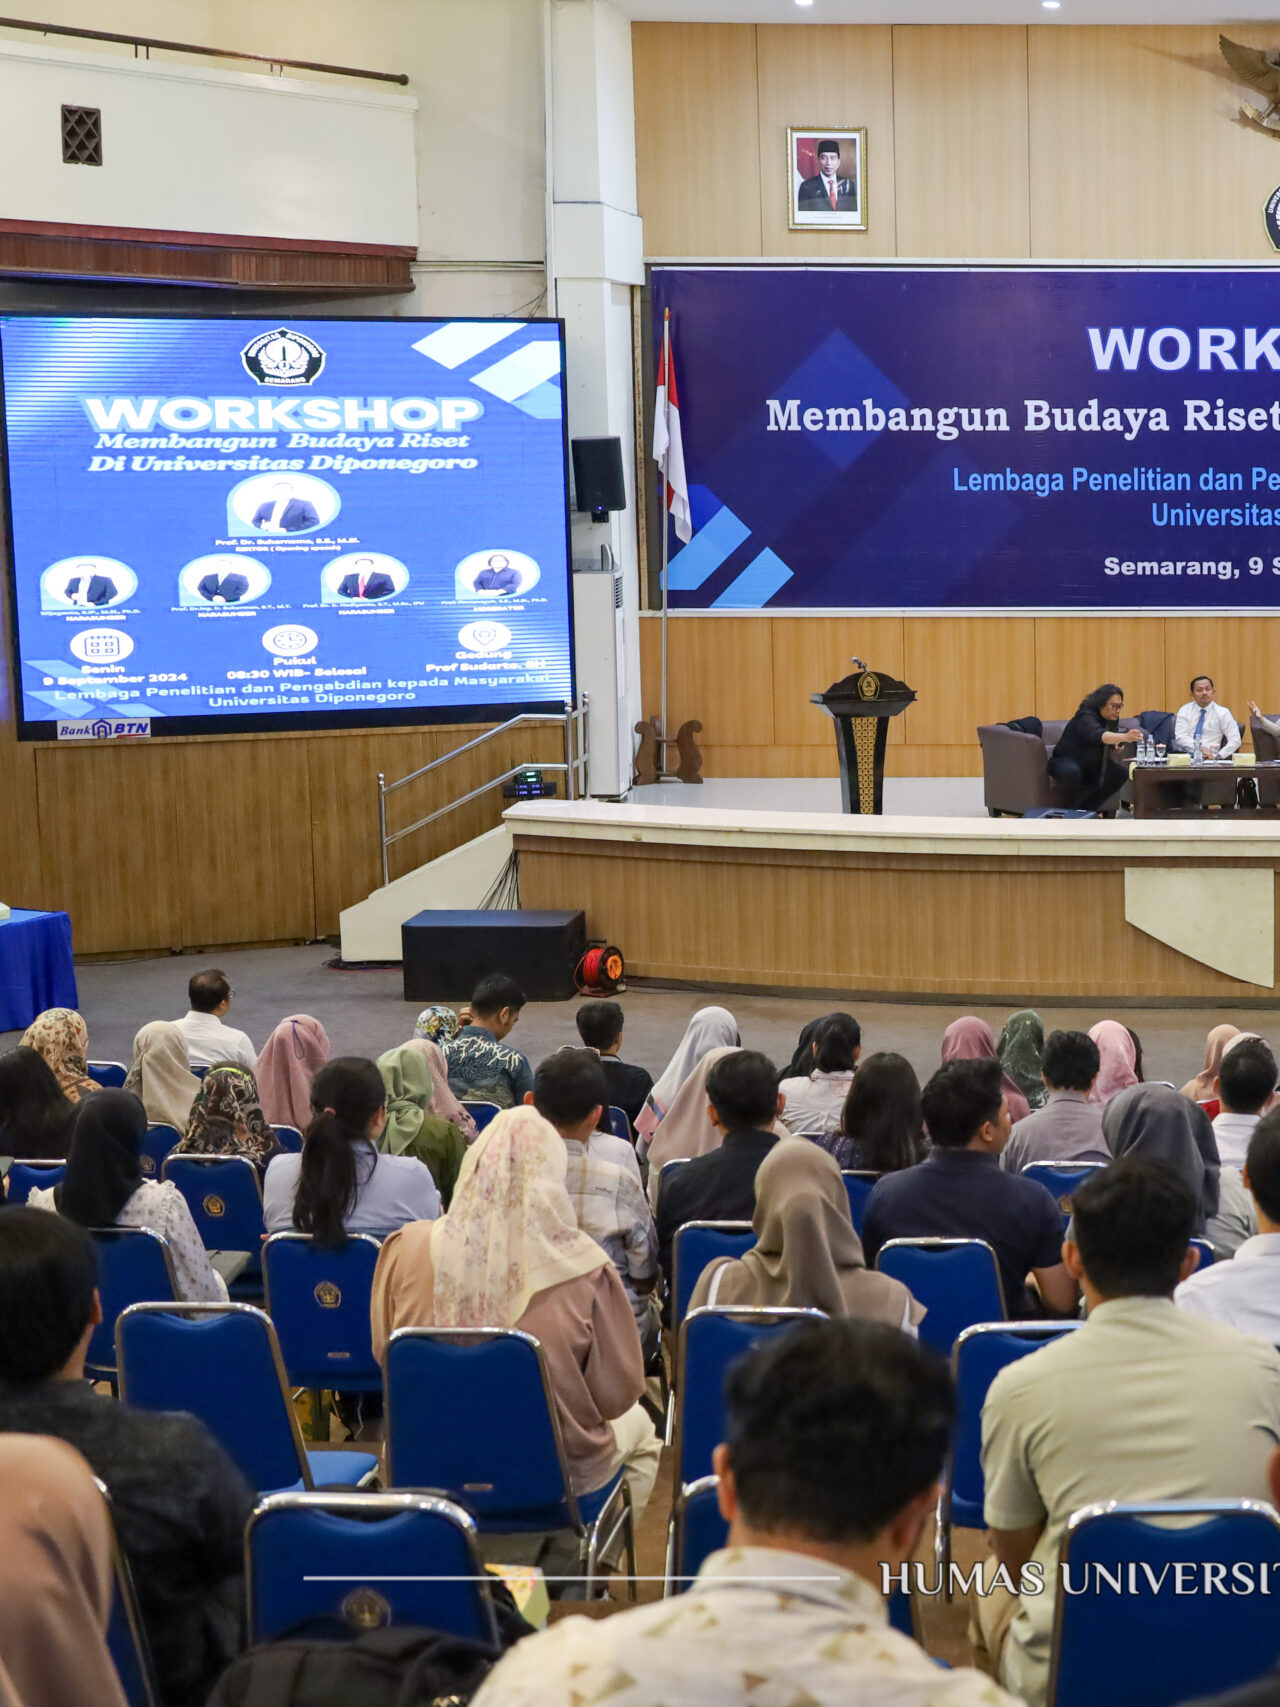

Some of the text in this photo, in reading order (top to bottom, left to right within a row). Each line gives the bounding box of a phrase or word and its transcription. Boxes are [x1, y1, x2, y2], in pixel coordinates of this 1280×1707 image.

[85, 399, 479, 430] WORKSHOP
[766, 398, 1010, 440] Membangun
[1024, 399, 1169, 440] Budaya
[95, 433, 470, 452] Membangun Budaya Riset
[88, 455, 478, 473] Di Universitas Diponegoro
[954, 468, 1063, 497] Lembaga
[1073, 468, 1190, 490] Penelitian
[1200, 468, 1242, 490] dan
[1104, 557, 1239, 579] Semarang,
[1249, 557, 1263, 575] 9
[274, 656, 317, 665] Pukul
[456, 650, 512, 661] Gedung
[81, 665, 125, 674] Senin
[227, 669, 270, 680] 08:30
[315, 666, 367, 676] Selesai
[426, 663, 459, 672] Prof
[43, 673, 188, 686] 9 September 2024
[55, 674, 551, 701] Lembaga Penelitian dan Pengabdian kepada Masyarakat
[209, 691, 416, 707] Universitas Diponegoro
[60, 723, 149, 736] Bank BTN
